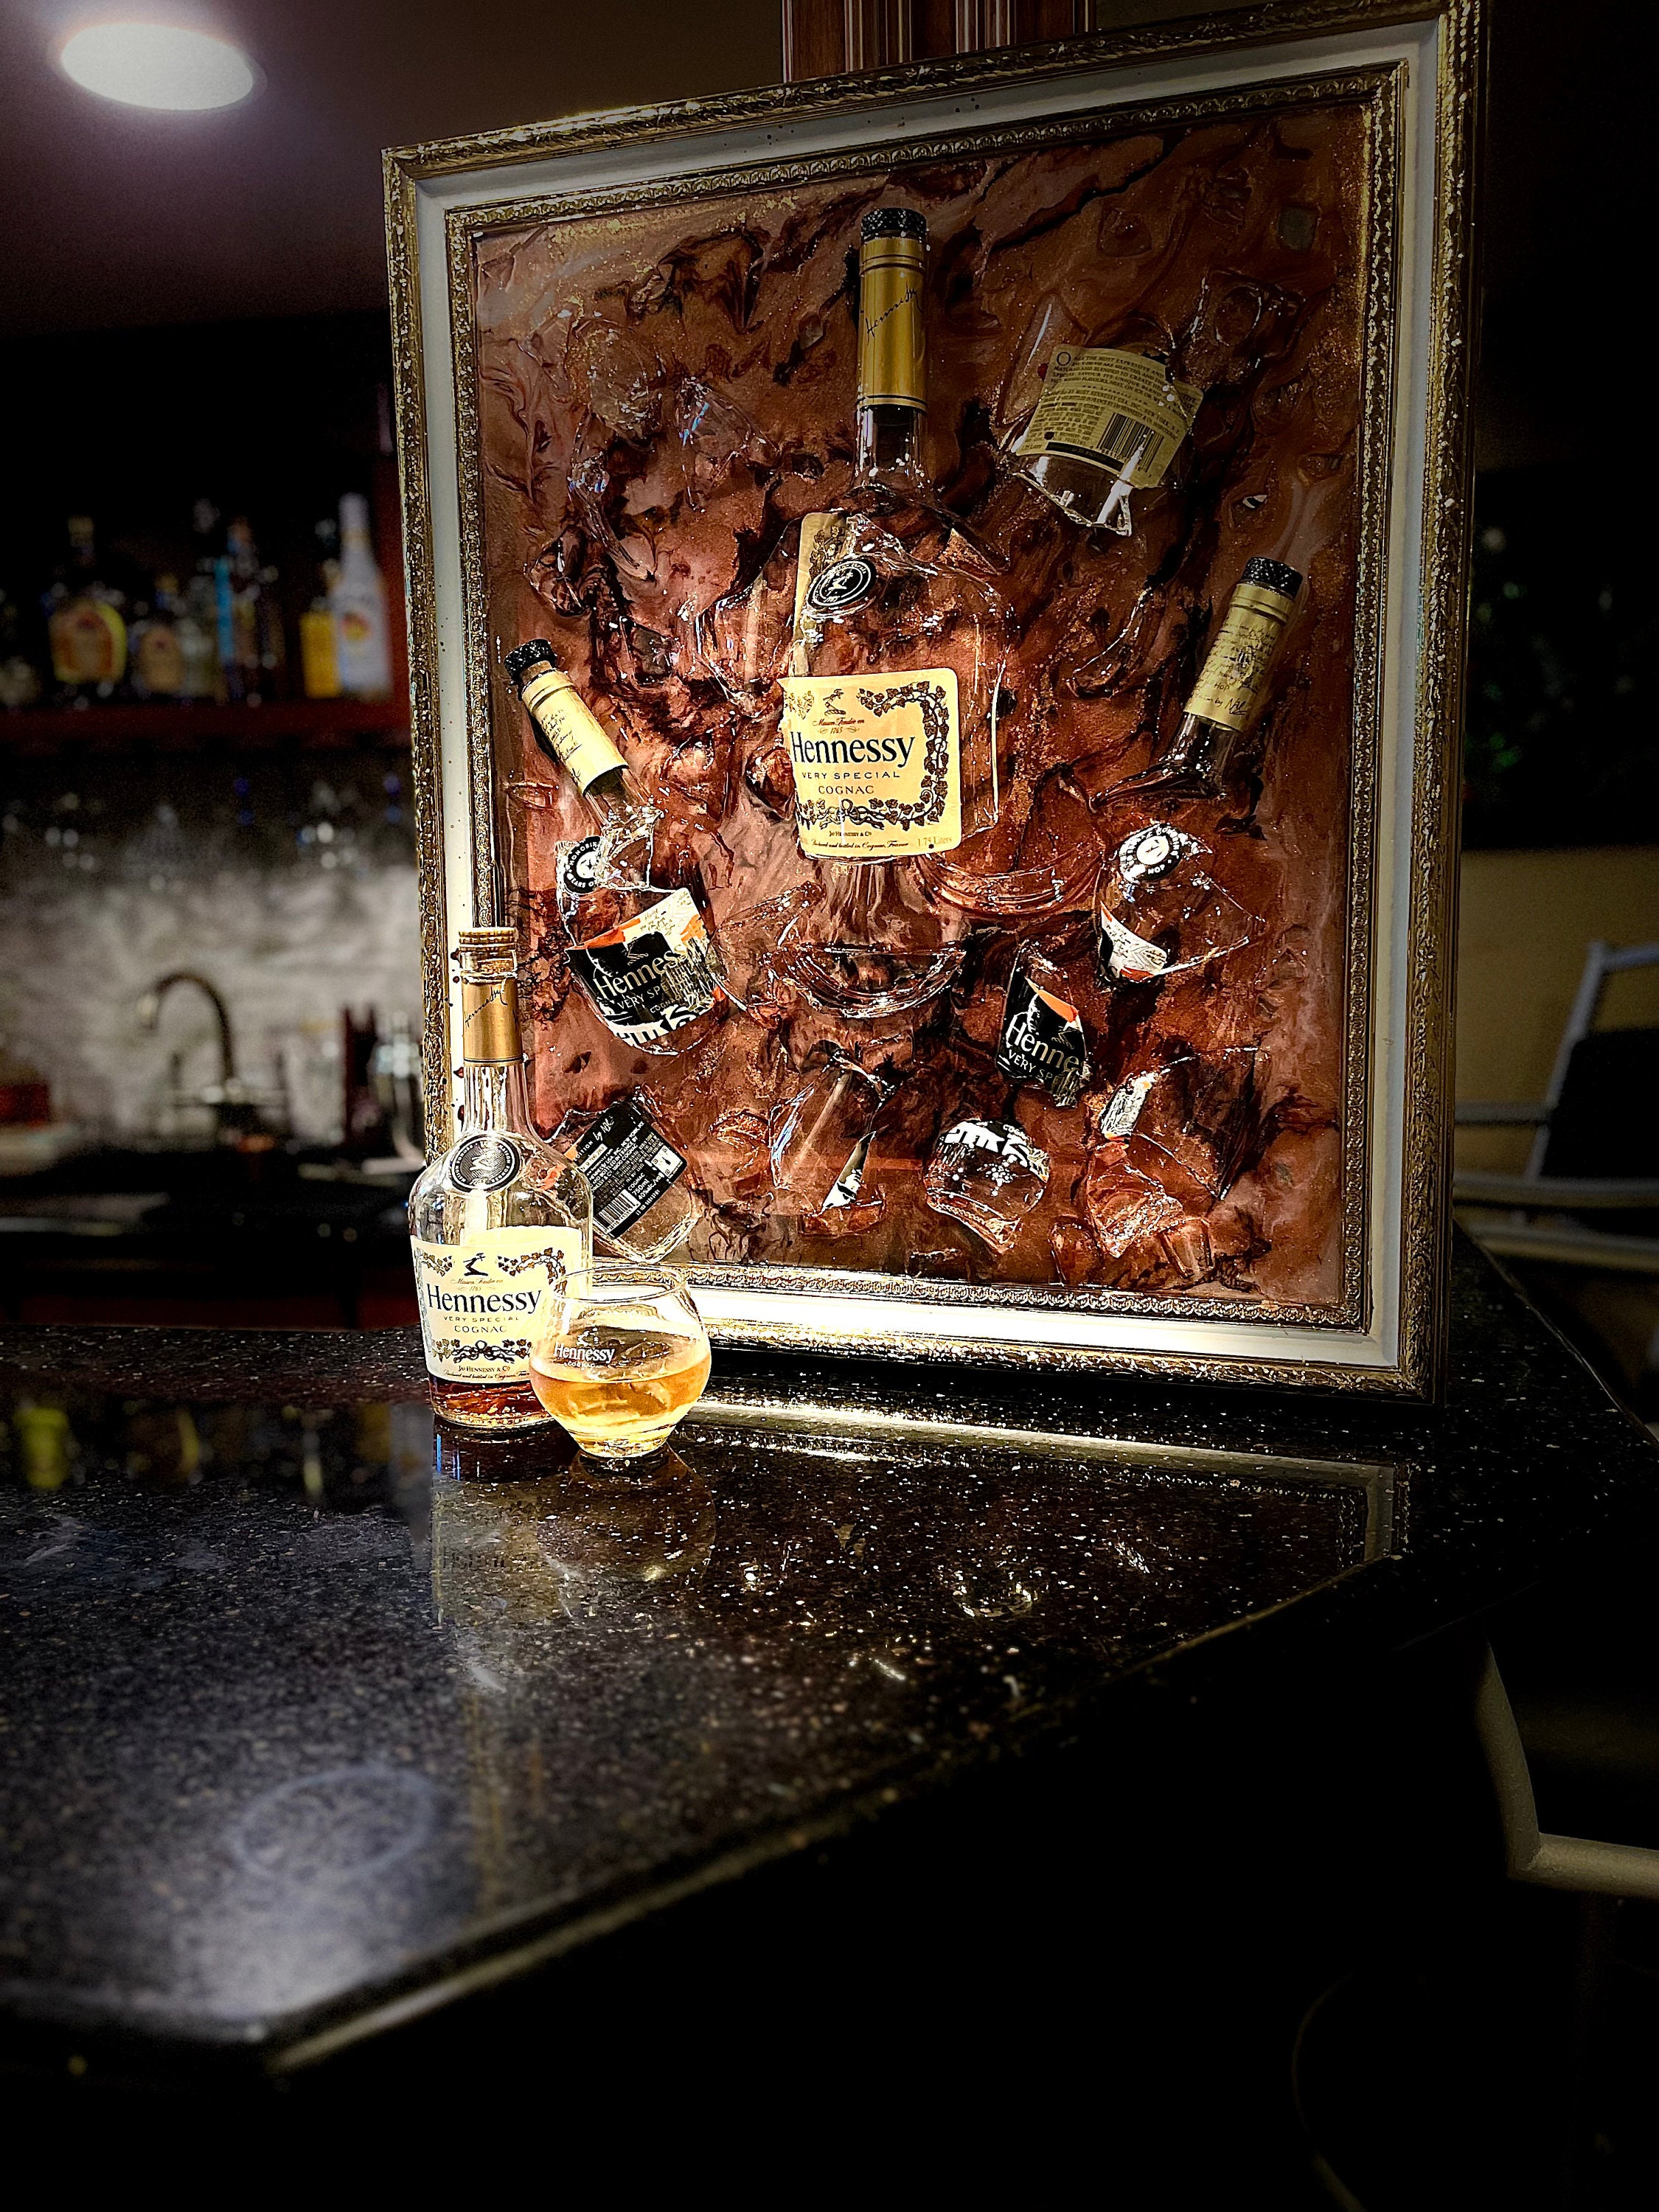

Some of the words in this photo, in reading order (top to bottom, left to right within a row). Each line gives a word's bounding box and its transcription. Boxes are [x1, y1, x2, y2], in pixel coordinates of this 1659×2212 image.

[1214, 681, 1231, 692] HOP
[790, 731, 915, 768] Hennessy
[834, 771, 900, 779] SPECIAL
[818, 785, 874, 795] COGNAC
[617, 993, 644, 1010] VERY
[1008, 1048, 1037, 1074] VERY
[599, 1159, 616, 1178] BOTTLED
[618, 1141, 633, 1157] FRANCE
[620, 1143, 639, 1161] COGNAC
[626, 1172, 645, 1192] COGNAC
[631, 1178, 650, 1197] 750ml
[427, 1284, 542, 1314] Hennessy
[554, 1342, 615, 1363] Hennessy
